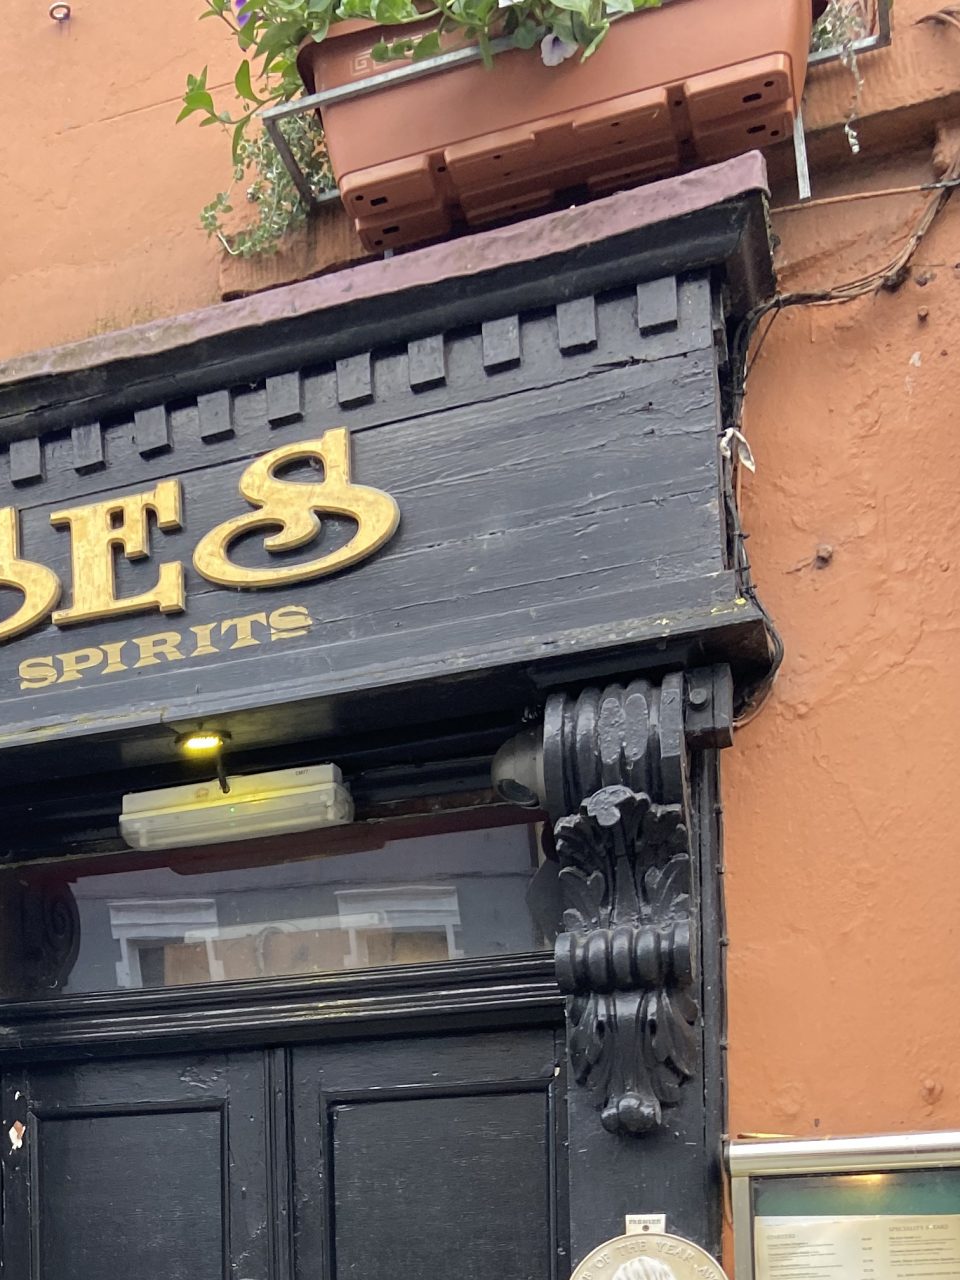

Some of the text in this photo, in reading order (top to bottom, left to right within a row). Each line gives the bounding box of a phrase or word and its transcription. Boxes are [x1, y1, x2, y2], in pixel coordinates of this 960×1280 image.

[19, 605, 313, 690] SPIRITS
[593, 1253, 612, 1270] OF
[655, 1239, 696, 1264] YEAR
